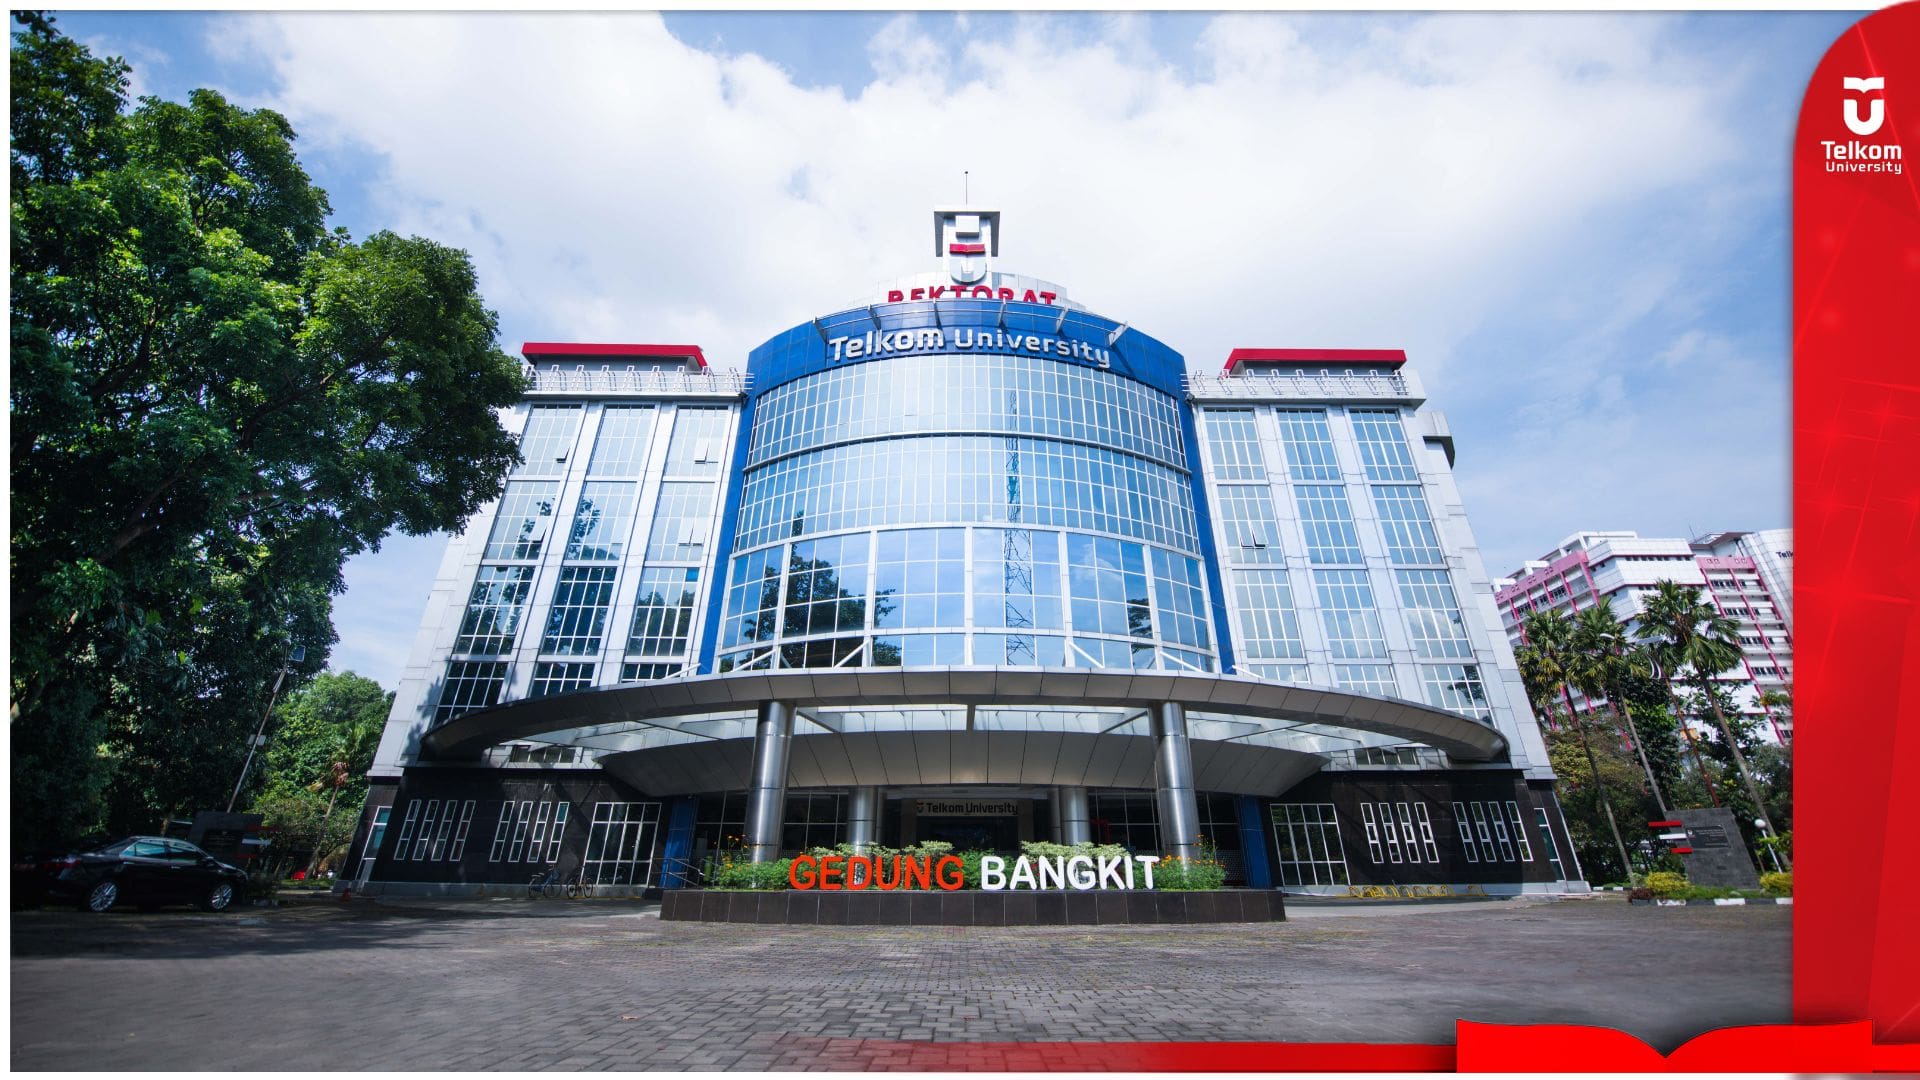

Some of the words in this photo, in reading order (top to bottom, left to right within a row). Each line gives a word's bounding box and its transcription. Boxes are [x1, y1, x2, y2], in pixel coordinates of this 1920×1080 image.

[829, 328, 944, 361] Telkom
[954, 329, 1110, 369] University
[926, 802, 964, 813] Telkom
[965, 802, 1018, 816] University
[789, 855, 964, 890] GEDUNG
[980, 855, 1160, 890] BANGKIT
